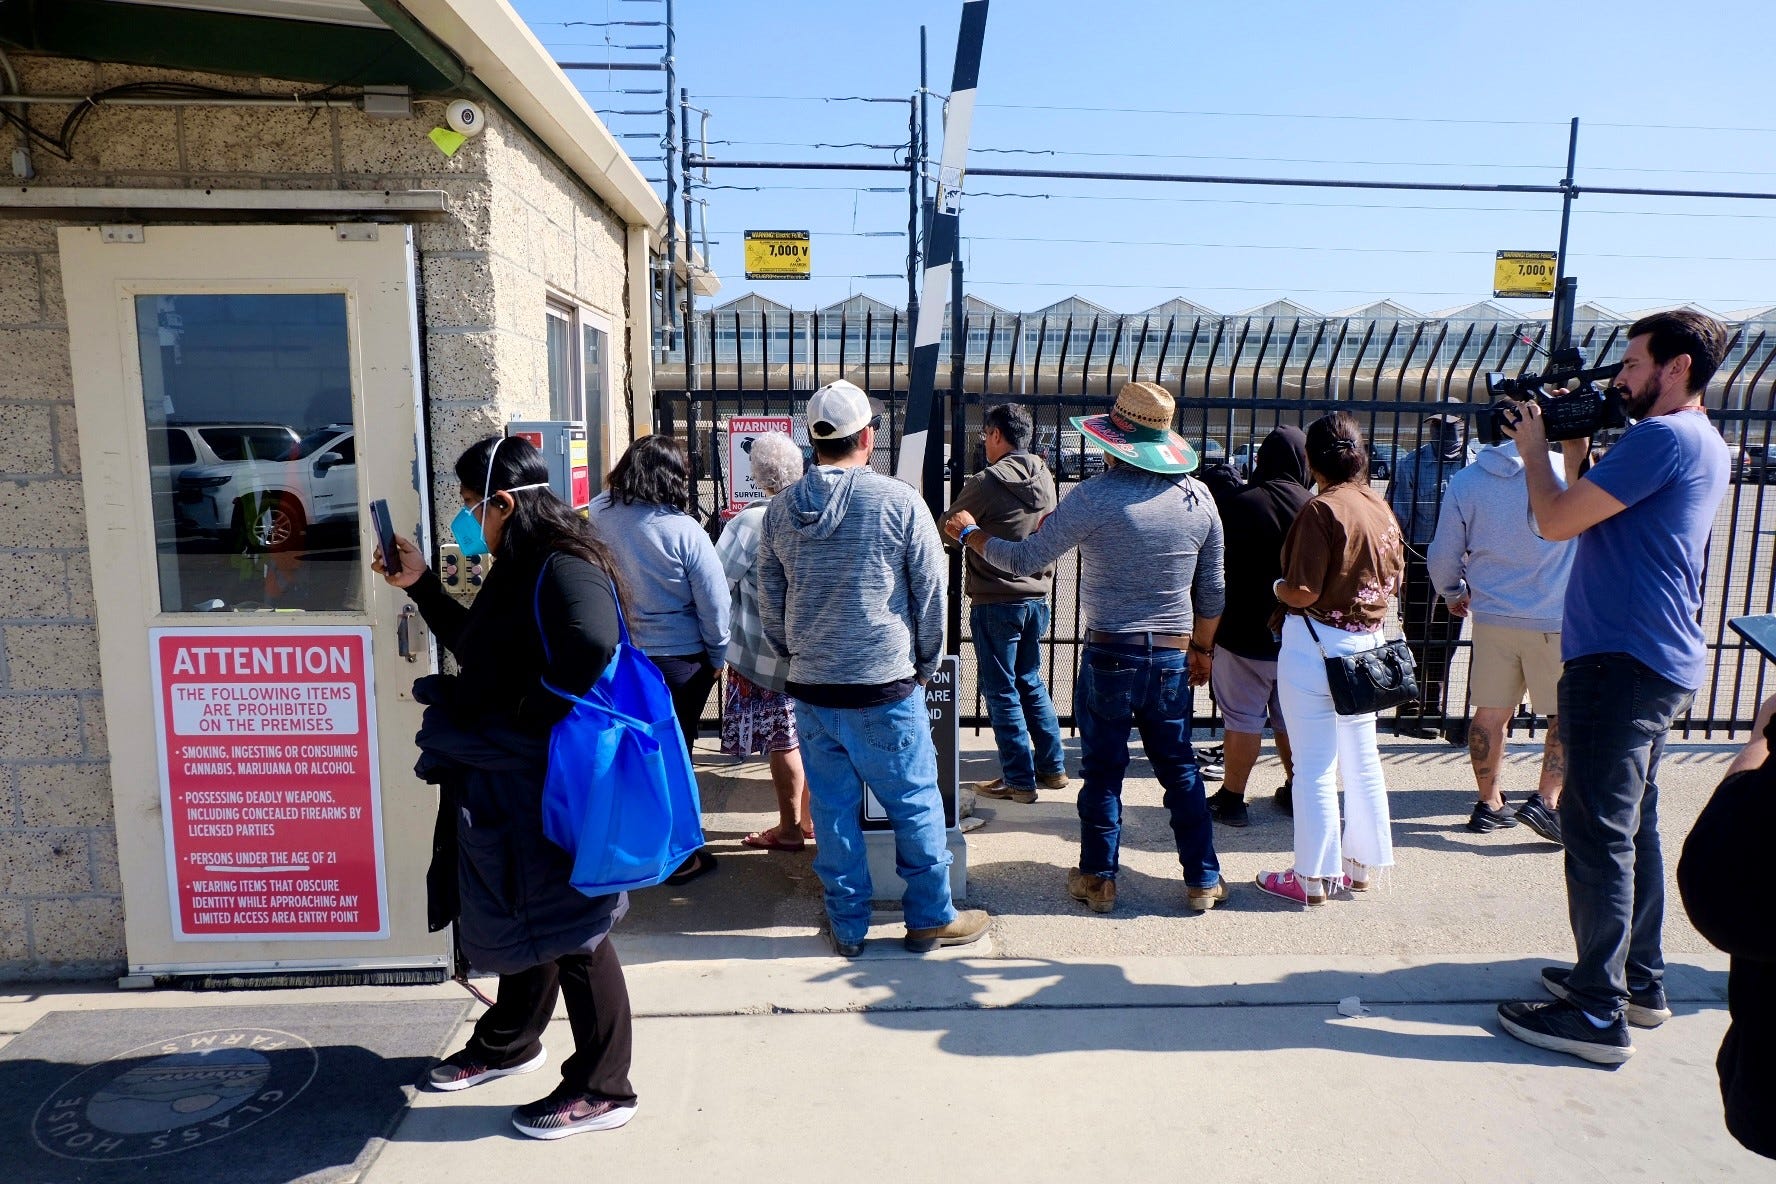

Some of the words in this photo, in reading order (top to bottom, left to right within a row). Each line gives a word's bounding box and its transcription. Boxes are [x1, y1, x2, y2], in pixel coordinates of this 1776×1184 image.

[769, 245, 798, 257] 7,000
[802, 247, 808, 256] V
[1519, 265, 1545, 276] 7,000
[1549, 267, 1554, 275] V
[732, 421, 788, 431] WARNING
[172, 647, 350, 674] ATTENTION
[178, 688, 205, 701] THE
[212, 688, 301, 700] FOLLOWING
[307, 687, 351, 700] ITEMS
[926, 690, 950, 702] ARE
[203, 704, 231, 716] ARE
[238, 703, 327, 716] PROHIBITED
[199, 719, 221, 731] ON
[227, 719, 255, 731] THE
[261, 718, 334, 731] PREMISES
[232, 746, 282, 758] INGESTING
[285, 746, 298, 758] OR
[301, 746, 358, 758] CONSUMING
[238, 762, 292, 774] MARIJUANA
[295, 762, 308, 774] OR
[311, 762, 356, 774] ALCOHOL
[185, 792, 243, 804] POSSESSING
[246, 791, 282, 803] DEADLY
[187, 808, 239, 820] INCLUDING
[242, 808, 298, 819] CONCEALED
[301, 808, 347, 819] FIREARMS
[350, 807, 362, 819] BY
[188, 825, 233, 836] LICENSED
[236, 824, 274, 836] PARTIES
[191, 853, 233, 864] PERSONS
[236, 852, 268, 864] UNDER
[272, 852, 288, 864] THE
[291, 852, 309, 864] AGE
[312, 852, 325, 863] OF
[327, 852, 336, 863] 21
[192, 881, 237, 892] WEARING
[240, 880, 266, 892] ITEMS
[270, 880, 293, 892] THAT
[296, 880, 340, 892] OBSCURE
[192, 897, 235, 908] IDENTITY
[238, 896, 268, 908] WHILE
[270, 896, 336, 908] APPROACHING
[339, 896, 358, 907] ANY
[193, 912, 230, 924] LIMITED
[233, 912, 269, 924] ACCESS
[272, 912, 296, 923] AREA
[299, 911, 327, 923] ENTRY
[331, 911, 359, 922] POINT
[161, 1034, 287, 1054] FARMS
[48, 1097, 125, 1152] HOUSE
[151, 1090, 283, 1149] GLASS
